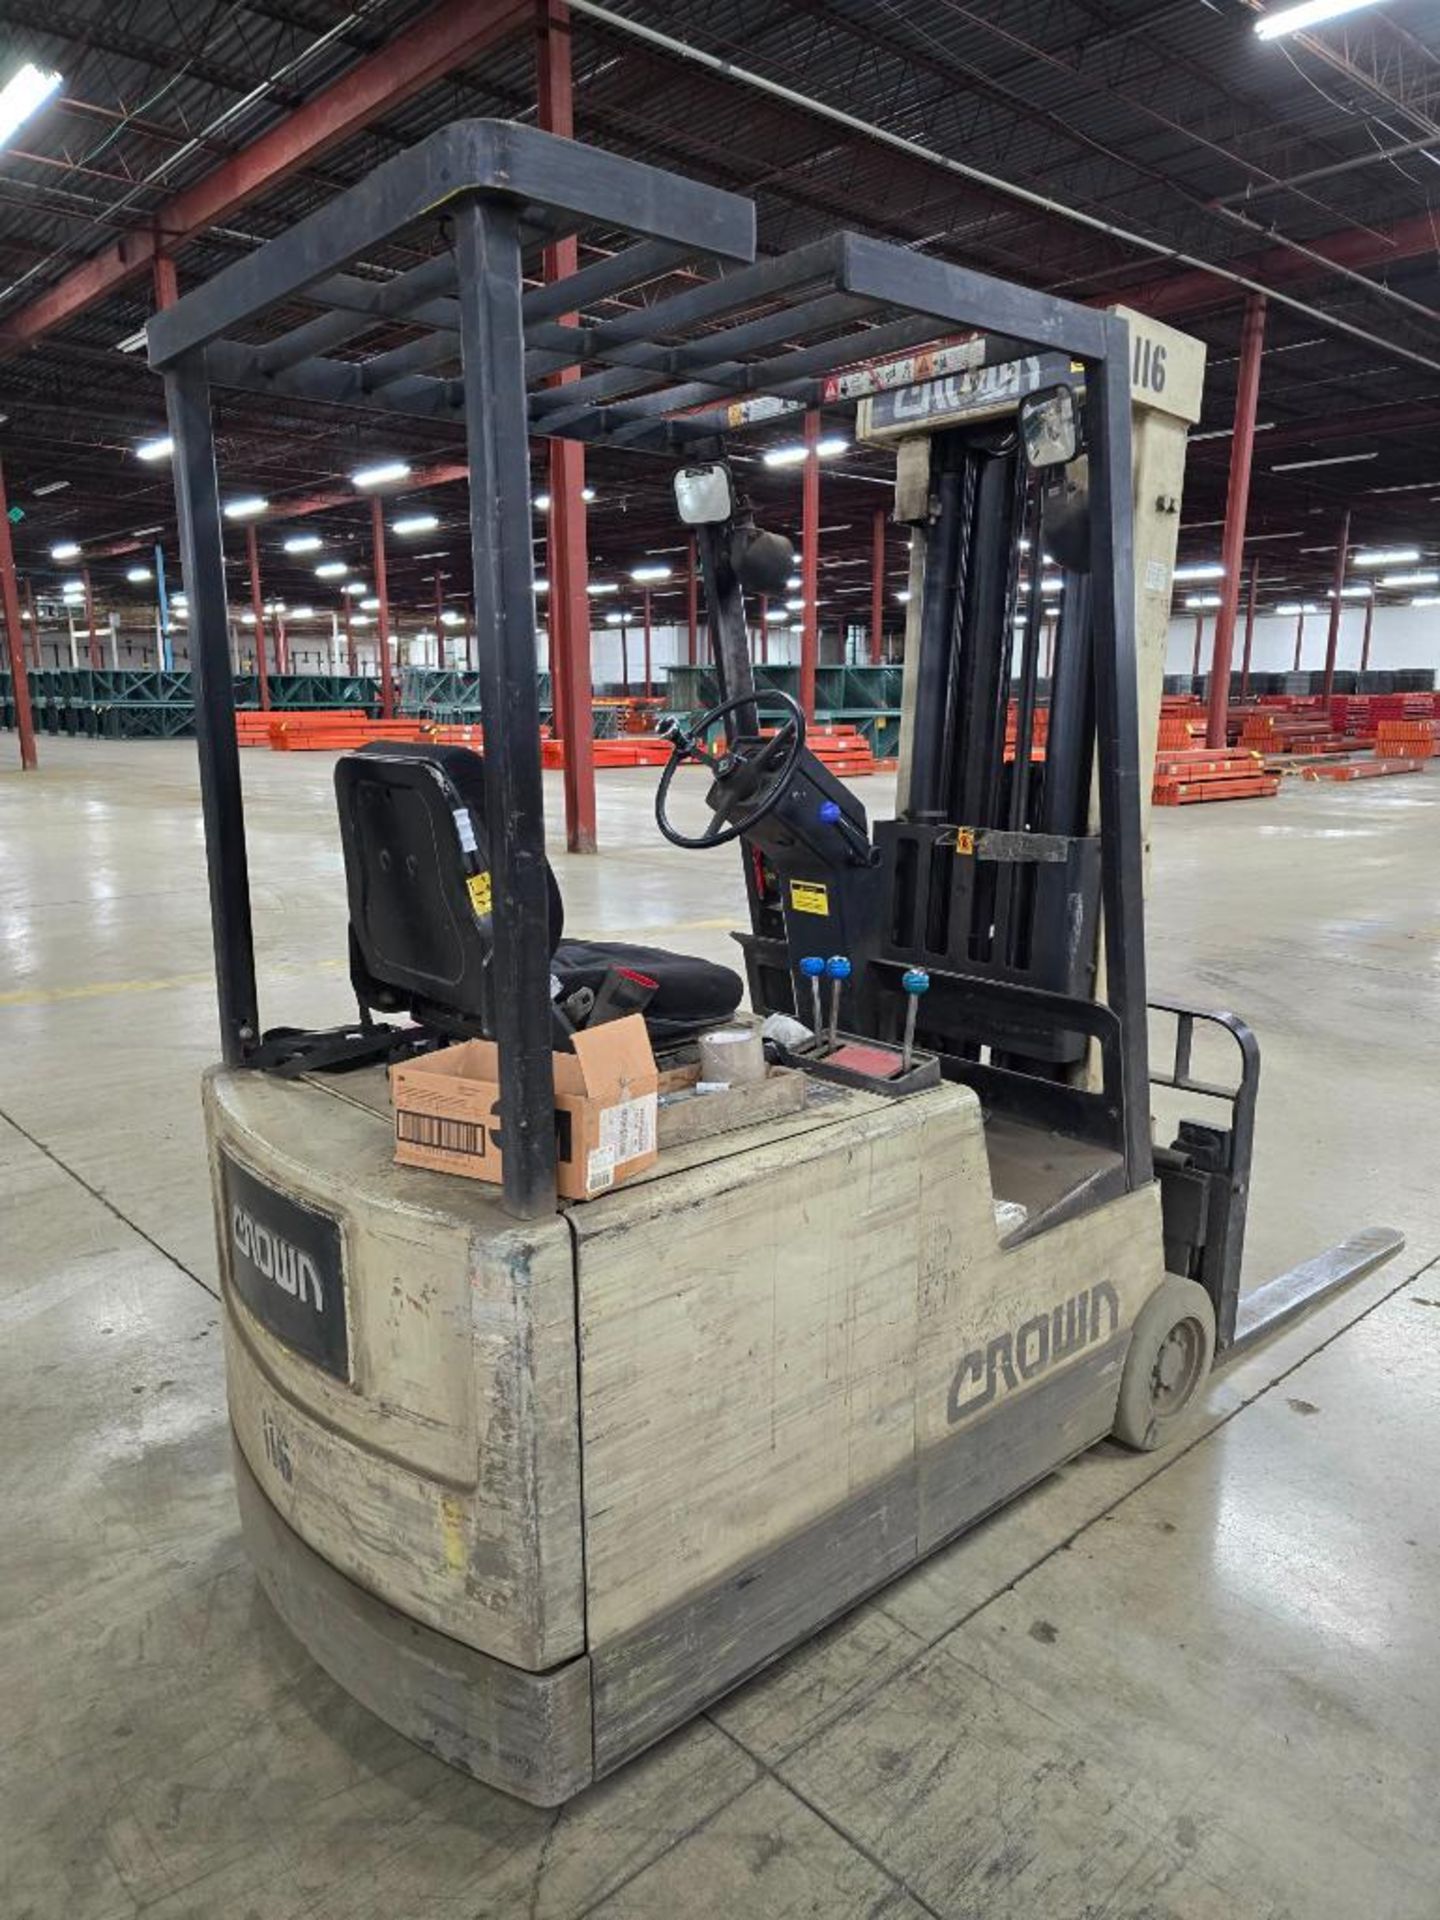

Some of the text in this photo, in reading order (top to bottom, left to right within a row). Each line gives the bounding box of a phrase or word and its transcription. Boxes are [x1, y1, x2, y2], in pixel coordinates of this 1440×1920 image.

[1133, 336, 1167, 393] 116
[233, 1205, 323, 1312] CROWN
[948, 1279, 1119, 1424] CROWN
